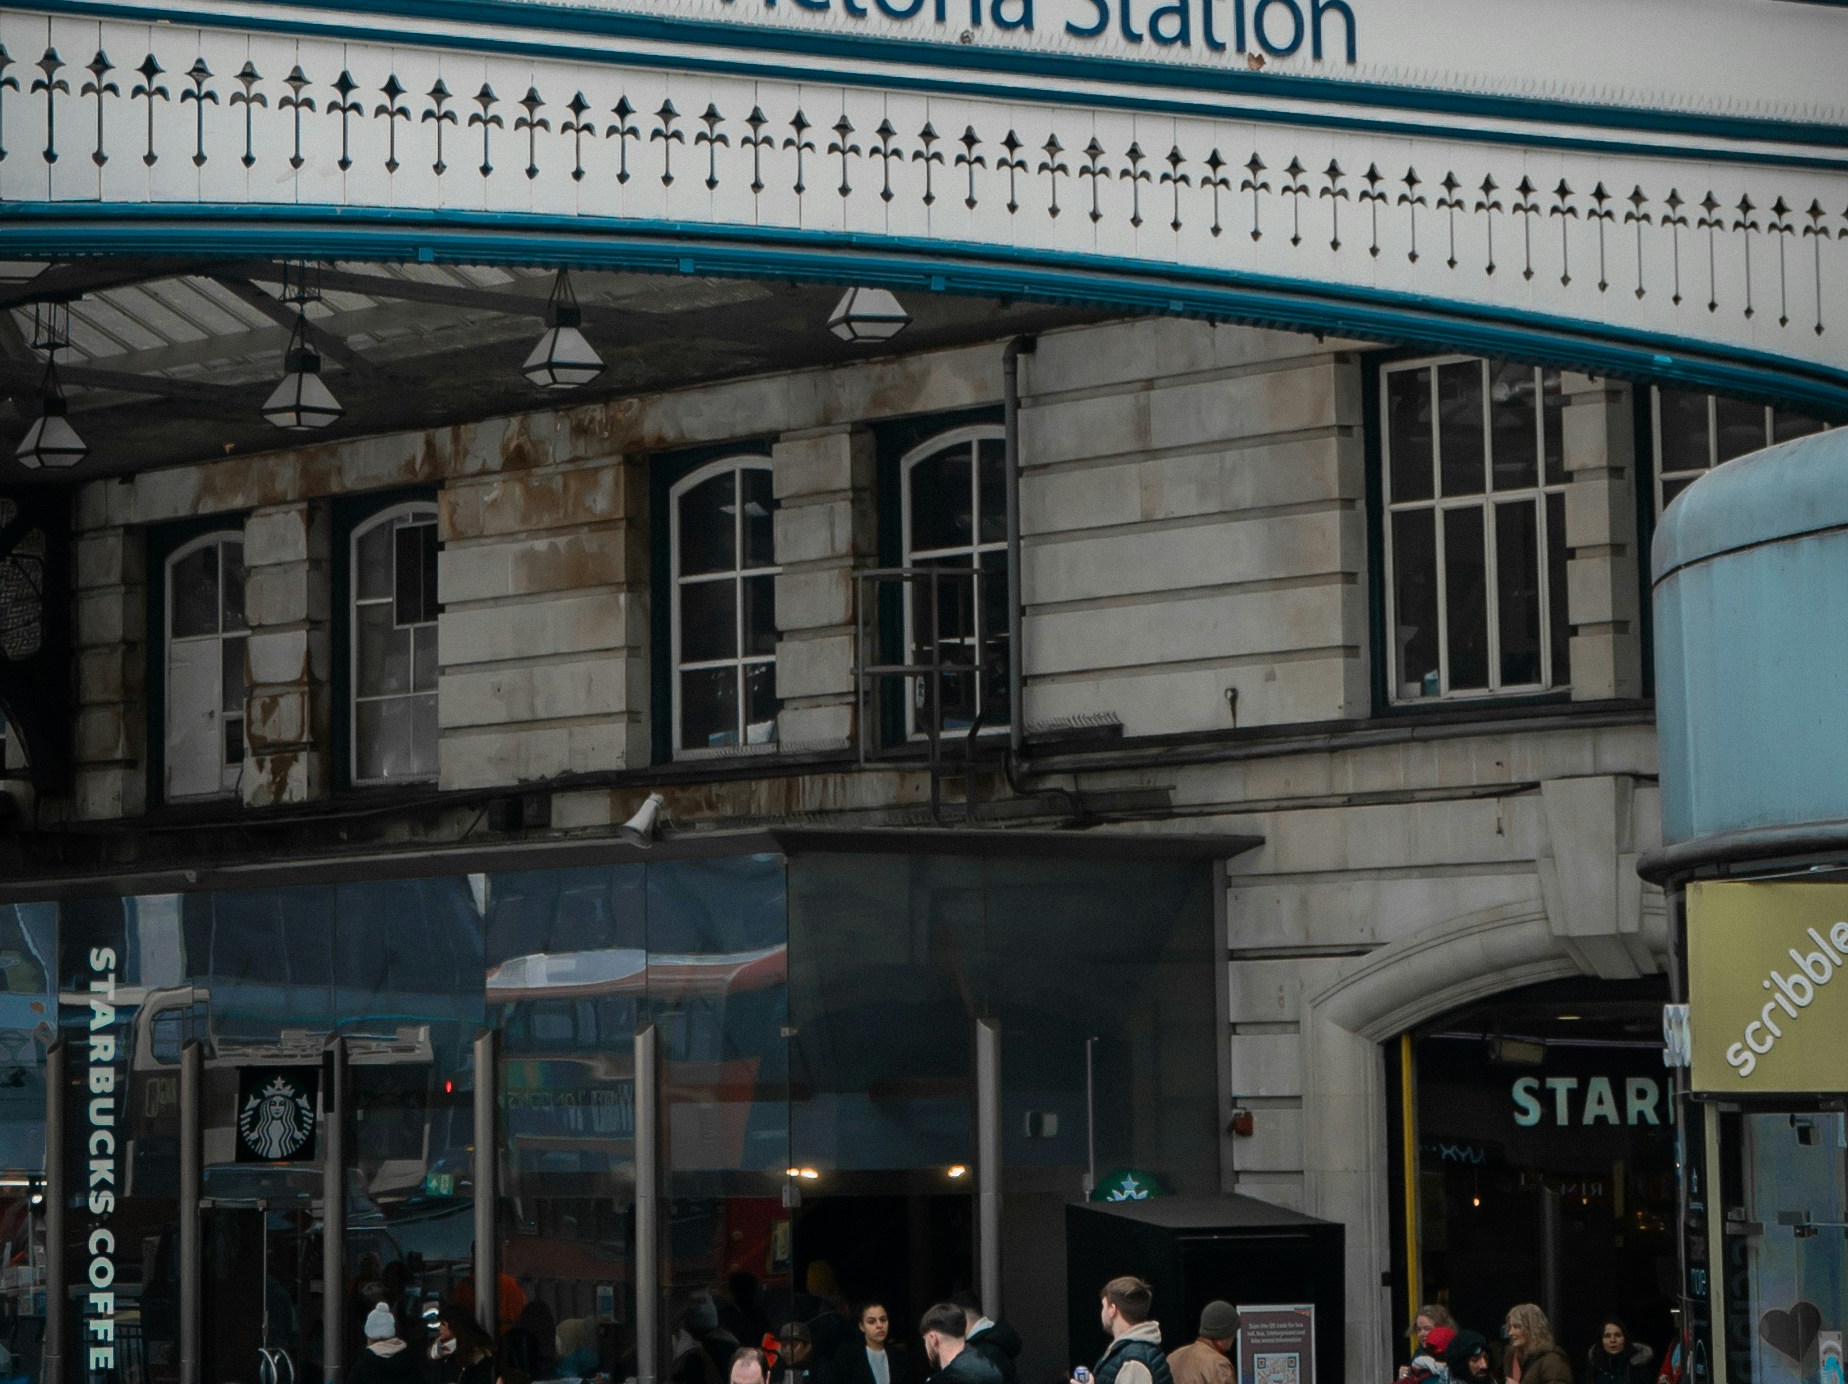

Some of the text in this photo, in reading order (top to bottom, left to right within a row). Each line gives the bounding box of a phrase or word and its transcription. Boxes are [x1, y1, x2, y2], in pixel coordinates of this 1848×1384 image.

[1726, 921, 1848, 1077] scribble
[88, 947, 116, 1370] STARBUCKS COFFE
[1512, 1076, 1675, 1126] STAR
